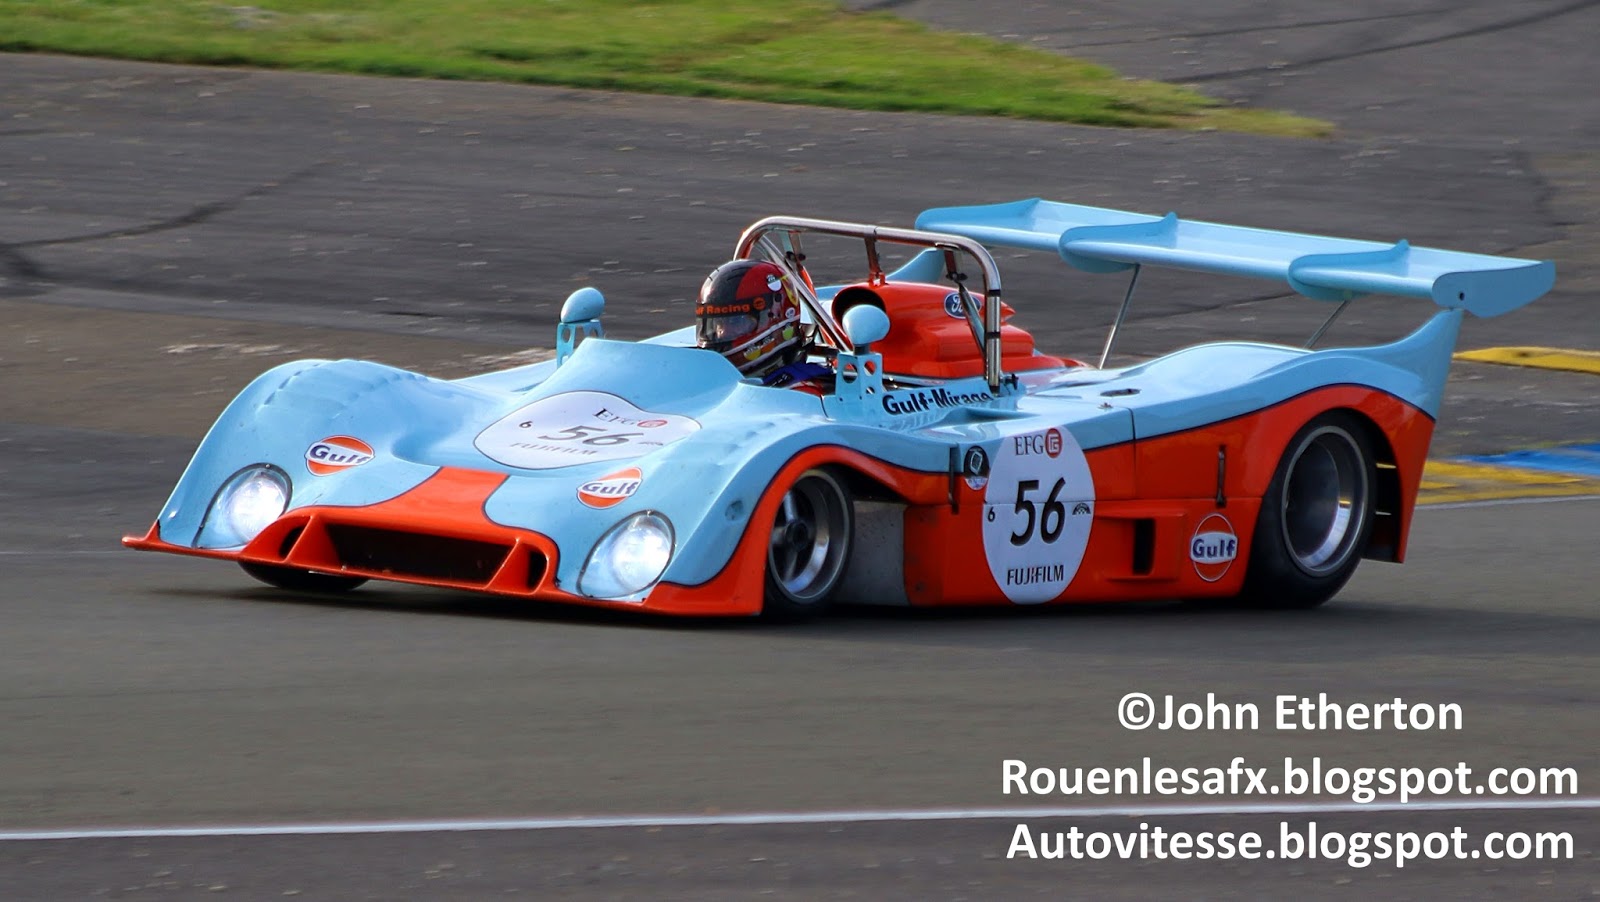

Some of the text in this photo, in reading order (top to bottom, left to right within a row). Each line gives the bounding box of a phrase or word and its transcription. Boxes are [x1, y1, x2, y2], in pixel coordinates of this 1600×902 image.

[706, 304, 750, 314] Racing
[519, 421, 533, 429] 6
[537, 425, 644, 446] 56
[1014, 434, 1044, 456] EFG
[309, 444, 371, 464] Gulf
[582, 481, 639, 495] Gulf
[987, 507, 996, 522] 6
[1010, 477, 1066, 547] 56
[1192, 538, 1236, 559] Gulf
[1006, 564, 1065, 586] FUJIFILM
